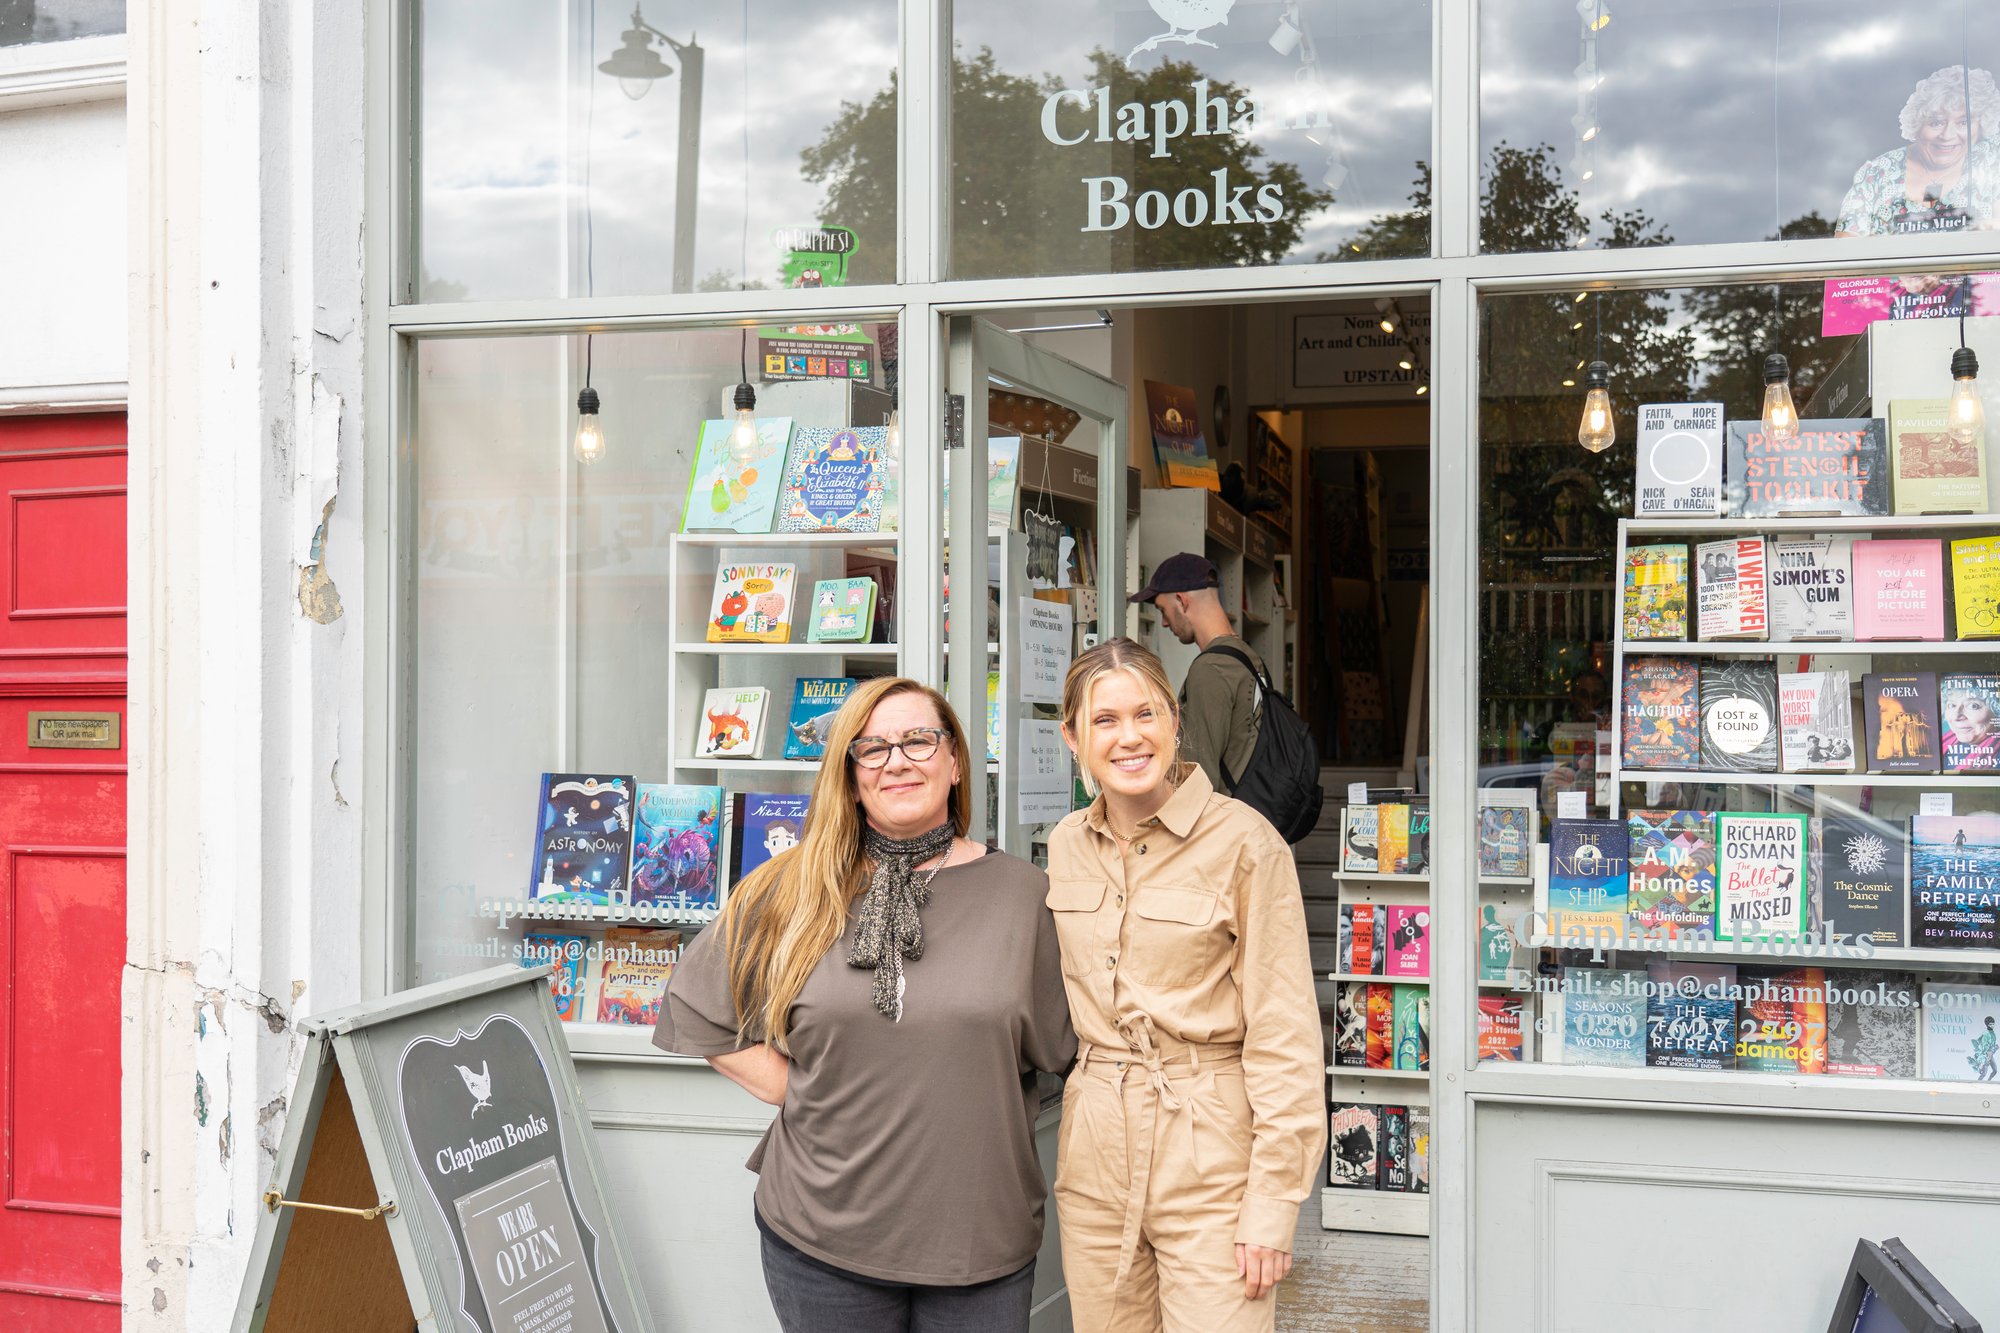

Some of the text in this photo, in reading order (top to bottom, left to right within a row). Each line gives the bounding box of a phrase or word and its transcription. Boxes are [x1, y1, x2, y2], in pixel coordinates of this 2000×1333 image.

[1081, 167, 1284, 232] Books
[1897, 221, 1929, 234] This
[1832, 290, 1848, 298] AND
[1893, 294, 1946, 307] Miriam
[1893, 304, 1967, 320] Margolyes
[1299, 334, 1430, 350] Art and Childrn's
[1645, 408, 1717, 420] FAITH, HOPE
[1645, 419, 1717, 430] AND CARNAGE
[1747, 431, 1867, 453] PROTEST
[820, 461, 857, 475] Queen
[807, 473, 859, 492] Elizabeth
[1073, 468, 1097, 489] Fiction
[1643, 487, 1665, 498] NICK
[1747, 480, 1869, 502] TOOLKIT
[1642, 498, 1715, 510] CAVE O'HAGAN
[1780, 551, 1815, 568] NINA
[722, 566, 763, 583] SONNY
[1773, 568, 1845, 586] SIMONE'S
[1877, 569, 1926, 578] YOU ARE
[1701, 585, 1715, 593] 1000
[1906, 580, 1913, 588] A
[1806, 587, 1840, 603] GUM
[1878, 589, 1927, 599] BEFORE
[1878, 600, 1927, 610] PICTURE
[803, 681, 848, 697] WHALE
[1945, 679, 1973, 689] This
[735, 693, 760, 704] HELP
[1782, 689, 1815, 700] MY OWN
[1882, 687, 1919, 698] OPERA
[1628, 704, 1692, 717] HAGITUDE
[1783, 701, 1811, 713] WORST
[1717, 711, 1744, 720] LOST
[1784, 714, 1810, 726] ENEMY
[53, 720, 67, 728] free
[68, 720, 109, 730] newspapers
[1717, 722, 1759, 731] FOUND
[53, 730, 64, 738] OR
[66, 729, 80, 739] junk
[1947, 744, 1994, 755] Miriam
[751, 805, 809, 818] Nikola Tesl
[1358, 826, 1376, 835] CODE
[548, 837, 624, 854] ASTRONOMY
[1578, 834, 1600, 846] THE
[1644, 847, 1696, 867] A.M.
[1727, 842, 1795, 860] OSMAN
[1555, 856, 1623, 876] NIGHT
[1736, 862, 1751, 870] The
[1944, 859, 1977, 872] THE
[1629, 872, 1712, 894] Homes
[1728, 866, 1780, 891] Bullet
[1926, 875, 1995, 890] FAMILY
[1750, 888, 1770, 898] That
[1834, 881, 1893, 892] The Cosmic
[1569, 887, 1607, 906] SHIP
[1847, 891, 1879, 901] Dance
[1920, 891, 2000, 907] RETREAT
[604, 889, 718, 925] Books
[1731, 896, 1791, 921] MISSED
[1353, 911, 1368, 919] Epic
[1563, 914, 1613, 923] JESS KIDD
[1631, 910, 1710, 925] The Unfolding
[1398, 909, 1422, 953] FOOLS
[1513, 911, 1876, 963] Clapham Books
[1925, 928, 1994, 939] BEV THOMAS
[512, 938, 685, 969] shop@clapham
[1400, 961, 1418, 969] SILBER
[609, 974, 659, 986] WORLDS
[1510, 968, 1982, 1009] Email: shop@claphambooks.com
[1575, 1000, 1632, 1014] SEASONS
[1675, 1004, 1707, 1019] THE
[1495, 1015, 1517, 1024] Debut
[1930, 1012, 1973, 1025] NERVOUS
[1495, 1026, 1521, 1035] Stories
[1576, 1012, 1638, 1038] 020
[1647, 1015, 1730, 1041] 7627
[1740, 1019, 1825, 1047] 2797
[1930, 1024, 1967, 1036] SYSTEM
[1575, 1036, 1632, 1050] WONDER
[1652, 1037, 1729, 1053] RETREAT
[1735, 1041, 1825, 1066] damage
[436, 1113, 549, 1175] Clapham Books
[497, 1201, 538, 1243] WE ARE
[495, 1225, 563, 1287] OPEN
[513, 1283, 574, 1324] FEEL FREE TO WEAR
[519, 1295, 576, 1333] A MASK AND TO USE
[541, 1310, 573, 1333] SANITISER
